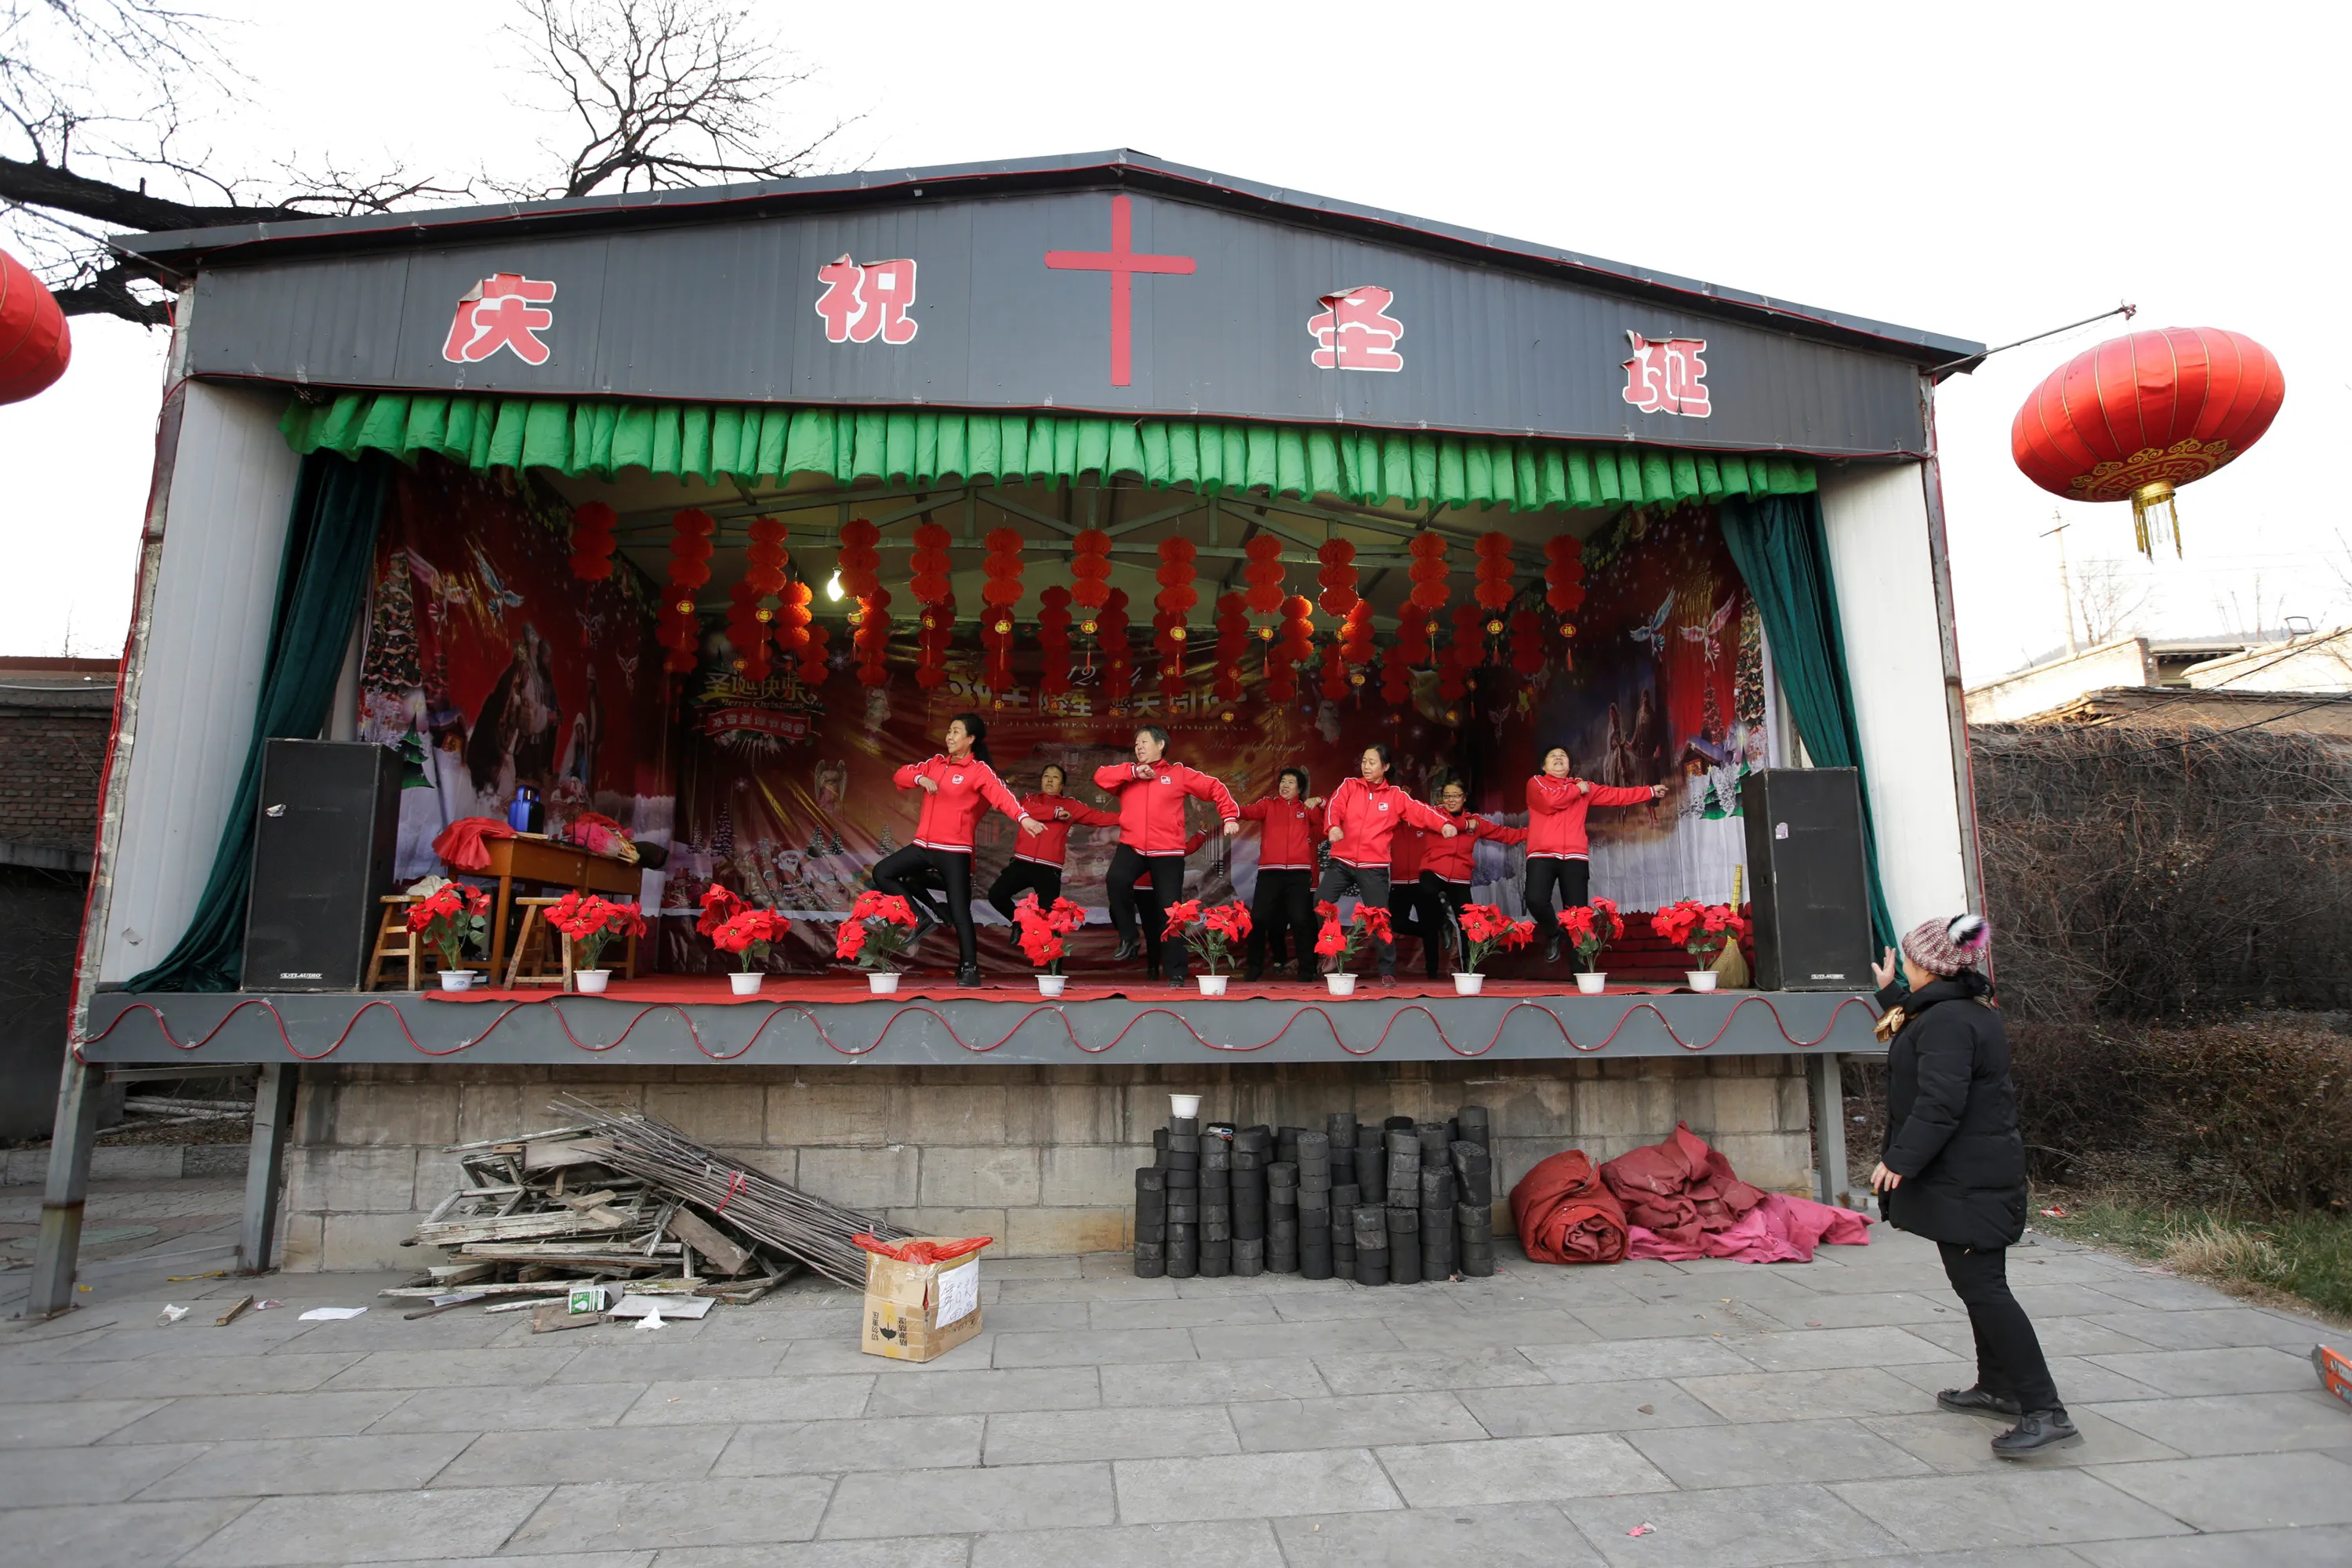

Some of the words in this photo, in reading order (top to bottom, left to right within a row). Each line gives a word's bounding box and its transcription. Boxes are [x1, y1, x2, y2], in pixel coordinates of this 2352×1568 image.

[442, 272, 557, 366] 庆
[815, 253, 919, 345] 祝
[1307, 285, 1404, 372] 圣
[1621, 329, 1712, 419] 诞
[753, 699, 805, 710] Christmas
